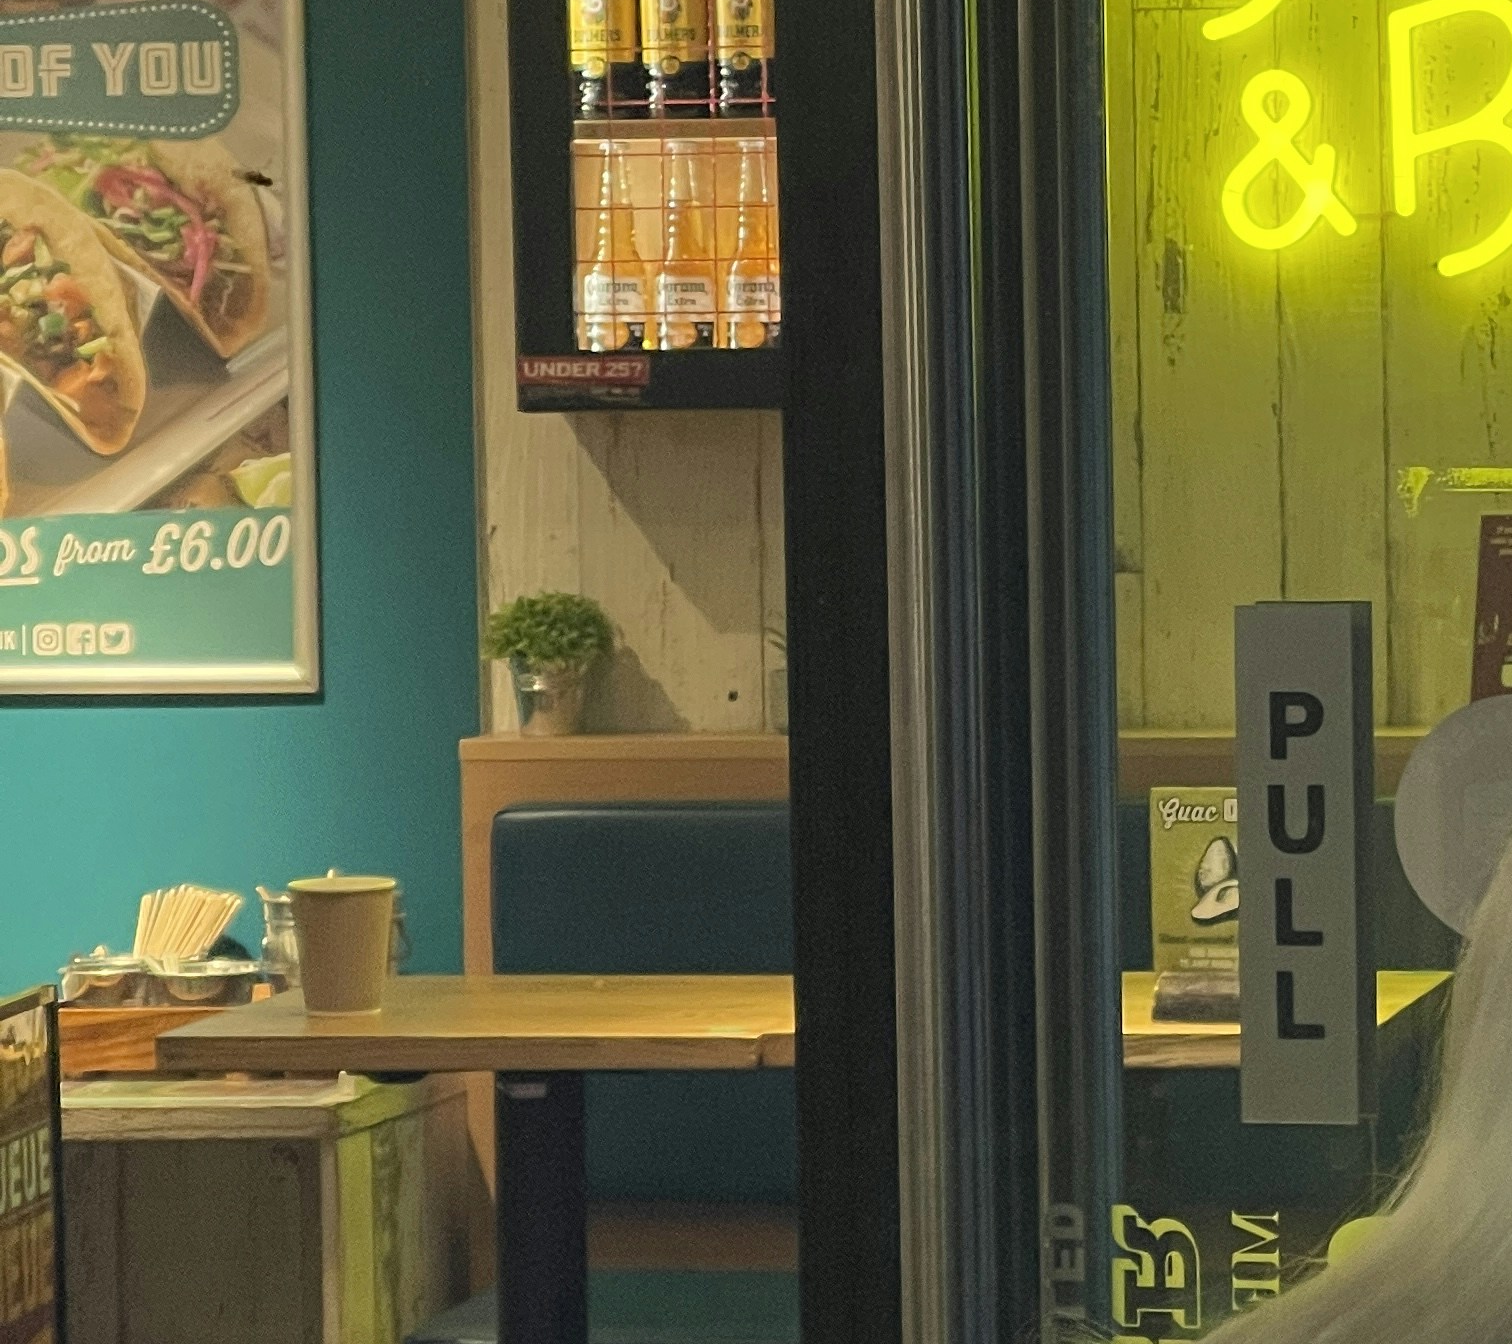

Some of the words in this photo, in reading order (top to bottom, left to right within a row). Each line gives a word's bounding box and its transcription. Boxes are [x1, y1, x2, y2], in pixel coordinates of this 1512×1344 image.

[720, 24, 762, 38] BULMER
[0, 43, 73, 99] OF
[92, 40, 222, 99] YOU
[1221, 67, 1358, 251] &
[523, 360, 600, 378] UNDER
[604, 360, 642, 378] 25?
[53, 533, 136, 577] from
[141, 514, 291, 575] £6.00
[1158, 797, 1219, 830] Guac
[1266, 690, 1327, 1041] PULL
